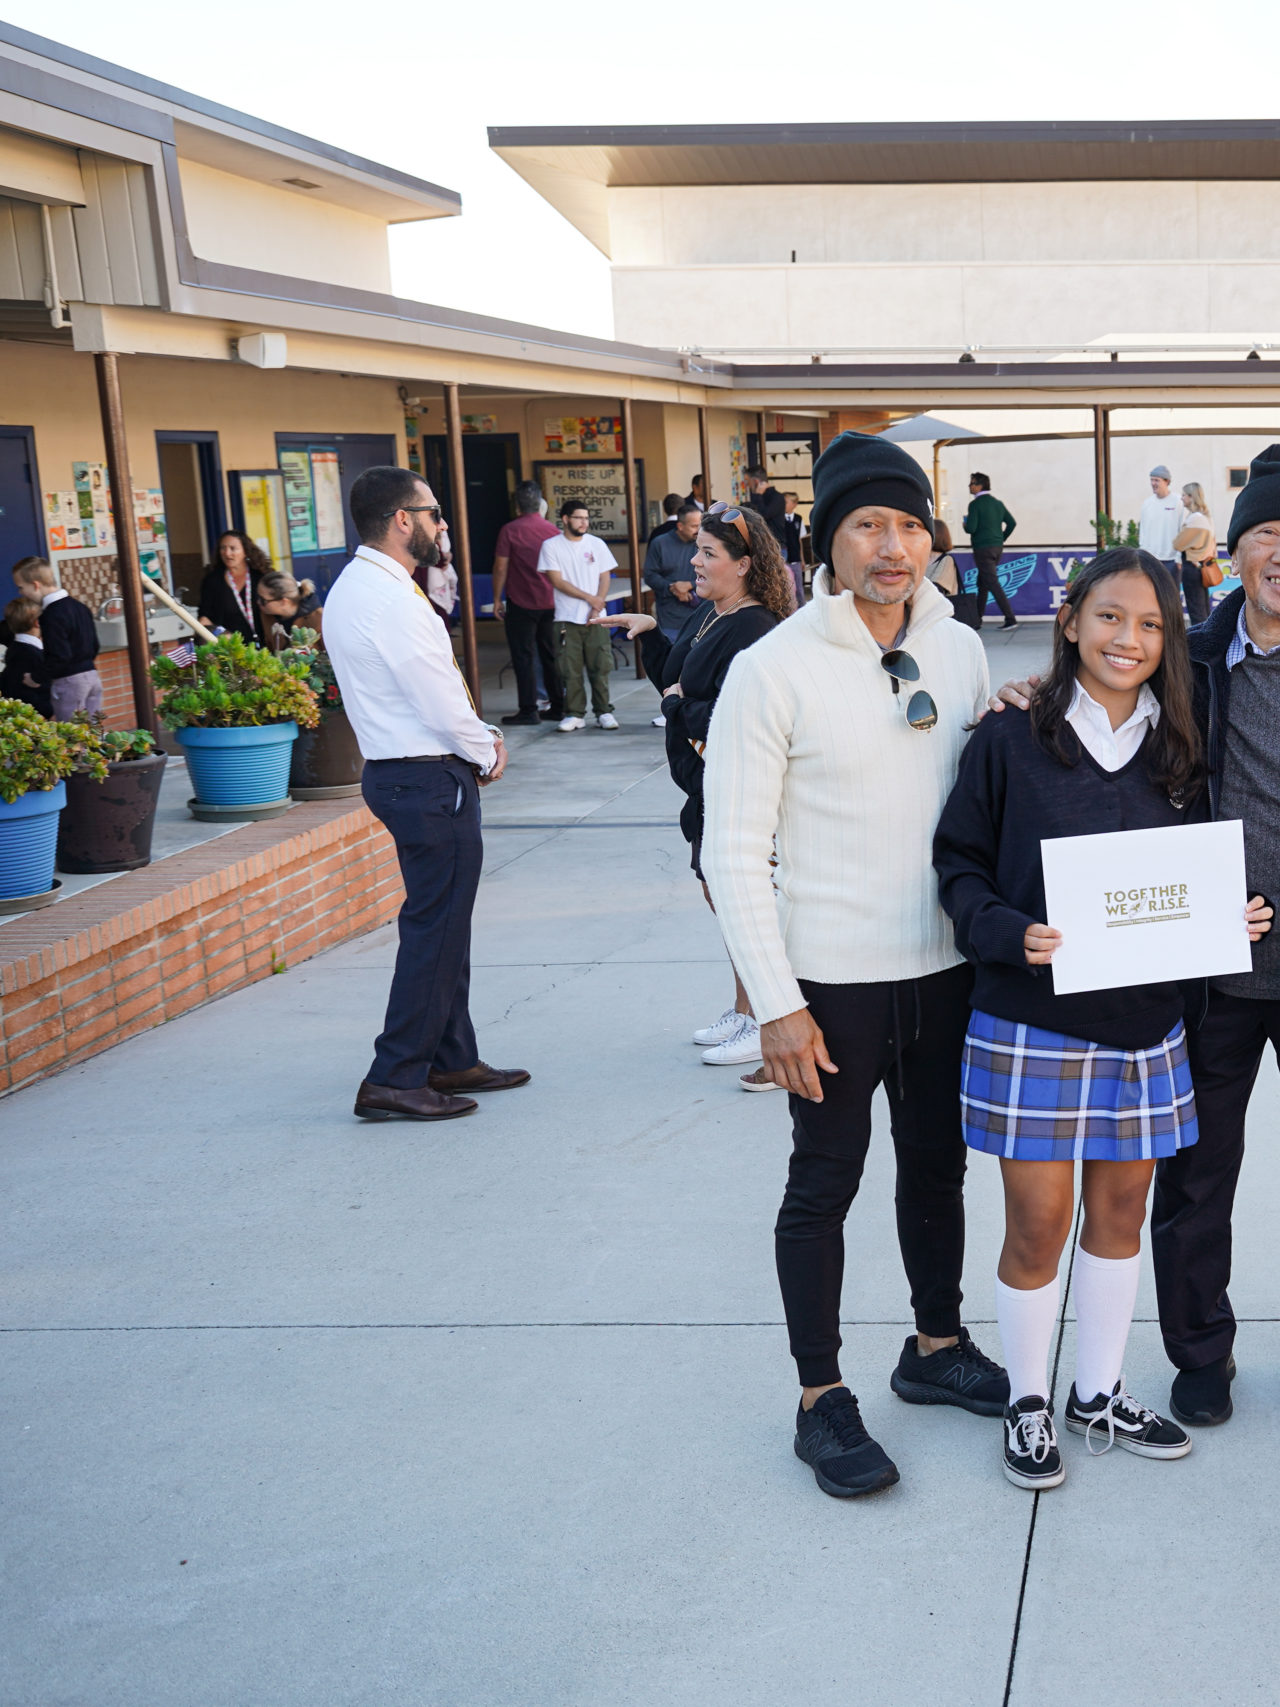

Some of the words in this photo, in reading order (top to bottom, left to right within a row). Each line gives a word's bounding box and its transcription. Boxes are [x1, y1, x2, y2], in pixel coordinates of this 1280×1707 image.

[568, 469, 595, 479] RISE
[600, 469, 615, 479] UP
[553, 485, 625, 495] RESPONSIBIL
[556, 497, 616, 507] IGRITY
[1104, 884, 1189, 904] TOGETHER
[1105, 903, 1128, 916] WE
[1148, 897, 1190, 912] R.I.S.E.
